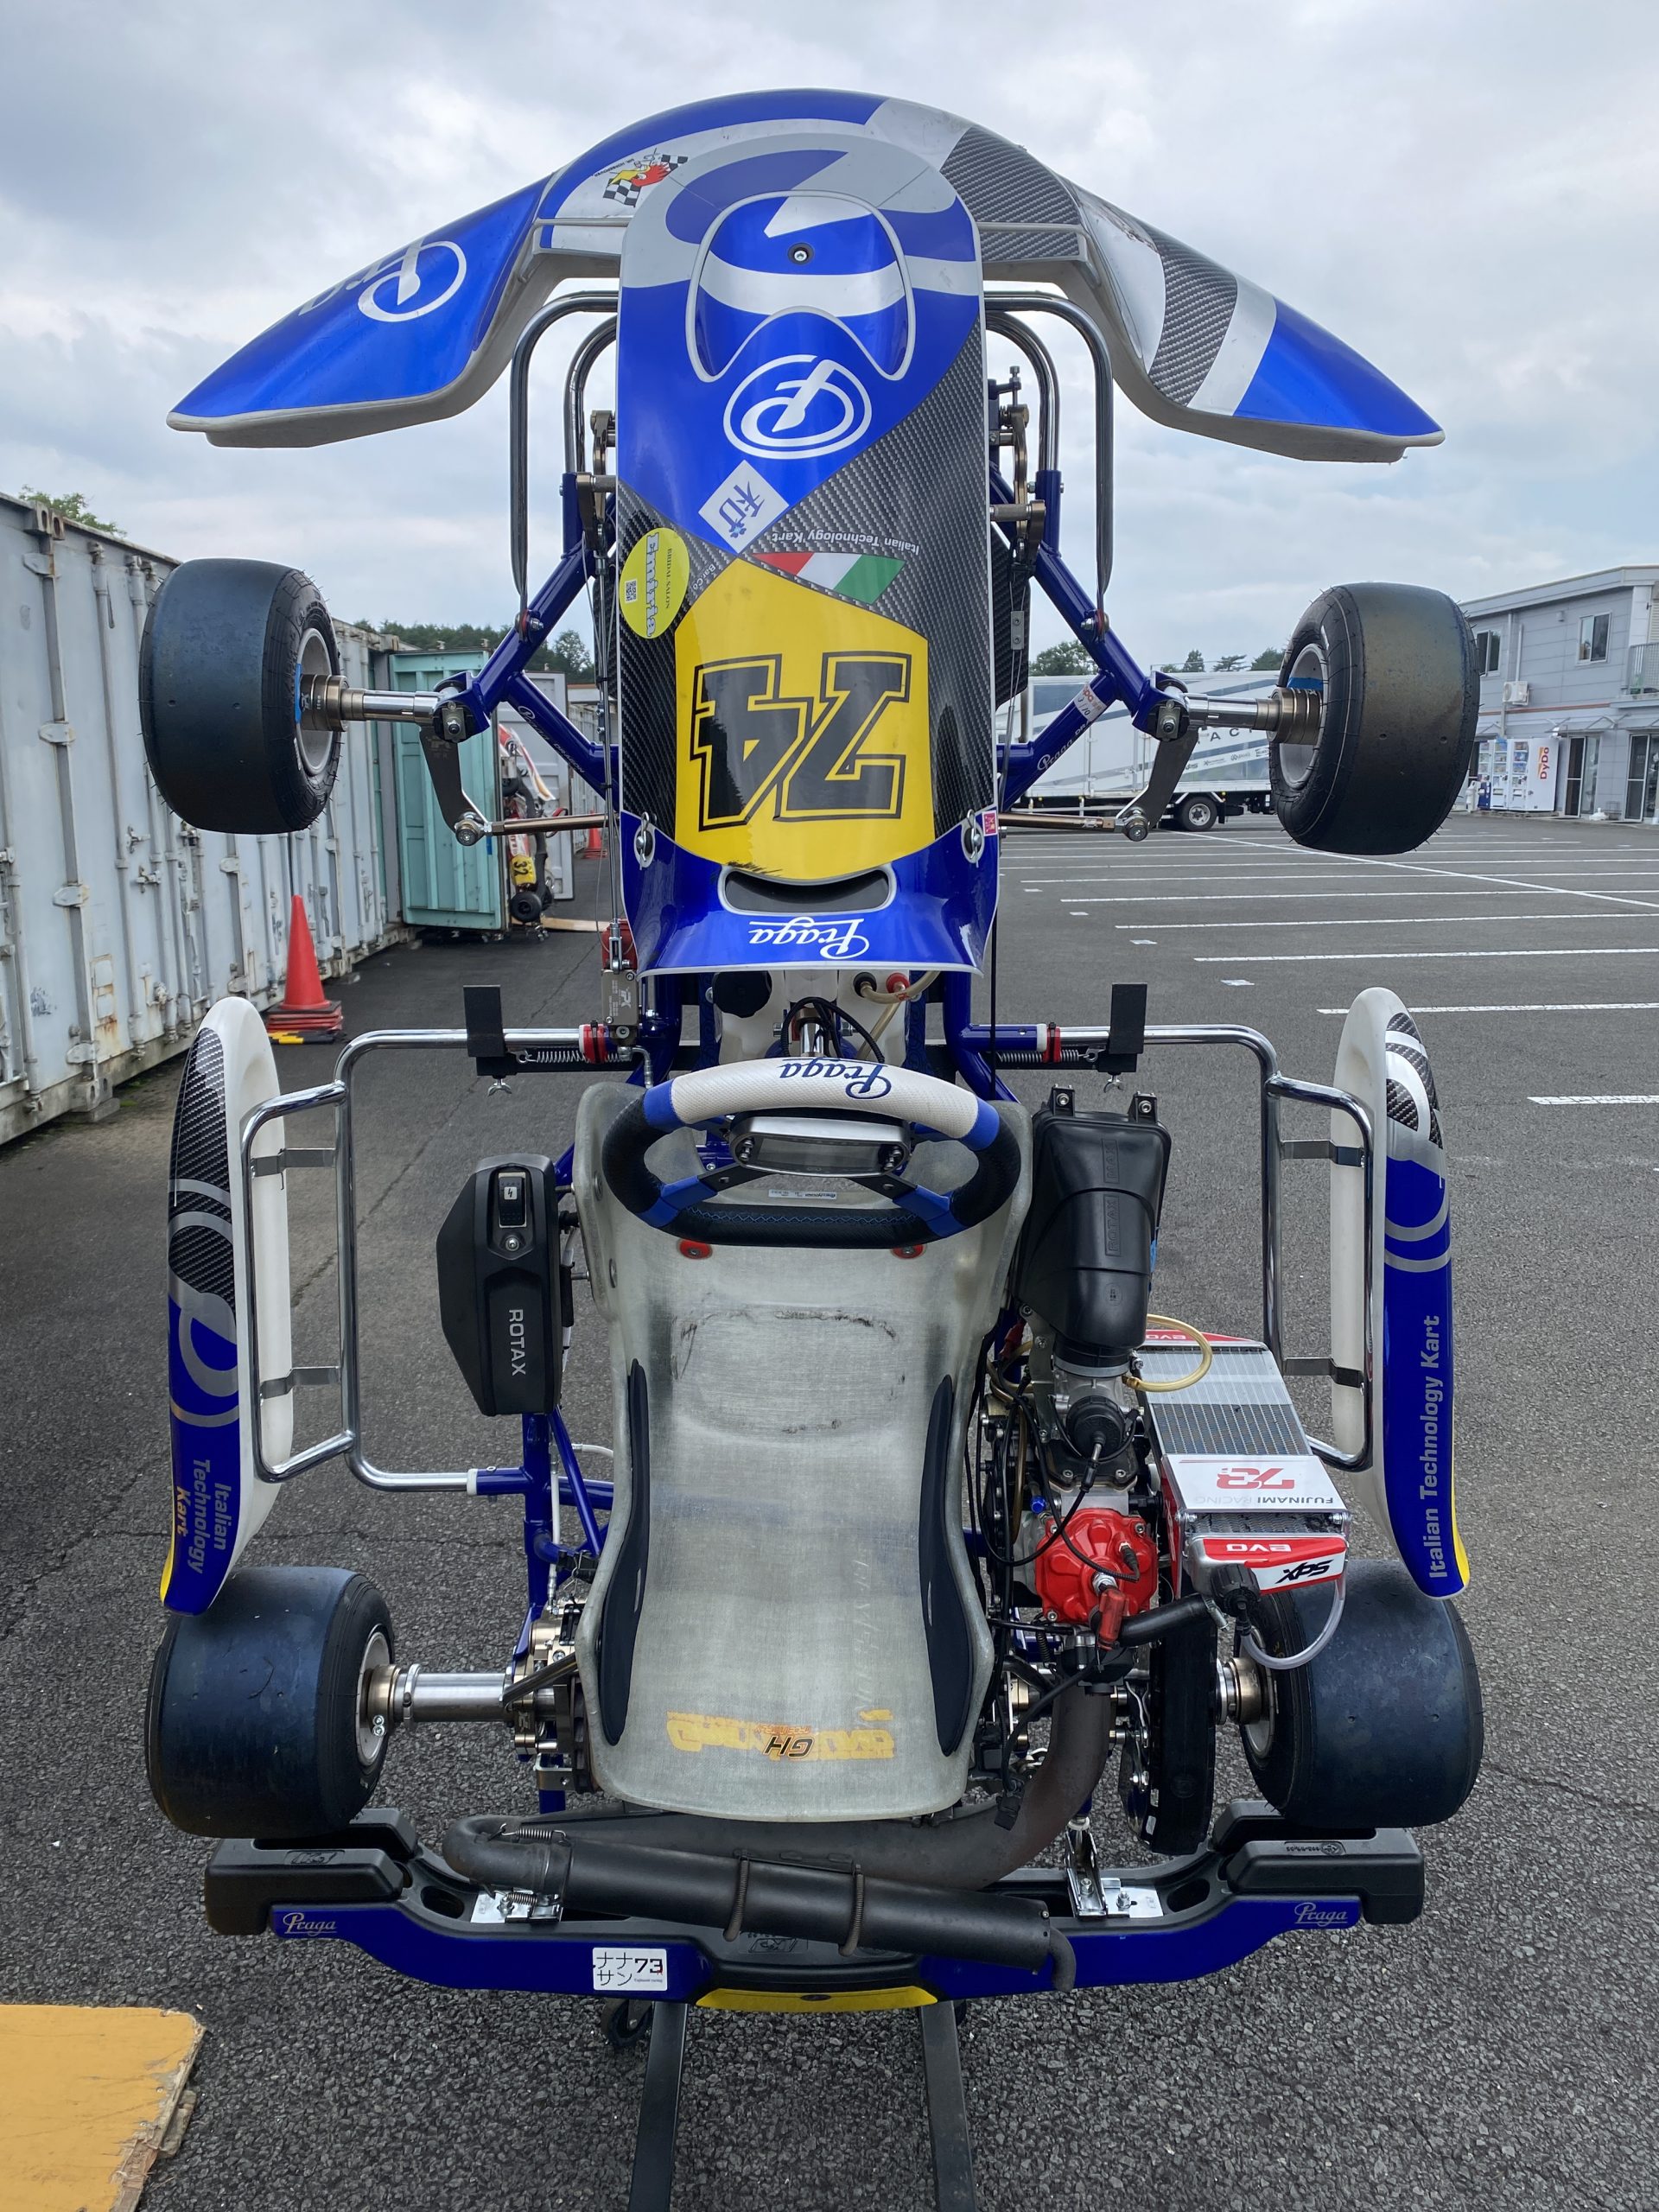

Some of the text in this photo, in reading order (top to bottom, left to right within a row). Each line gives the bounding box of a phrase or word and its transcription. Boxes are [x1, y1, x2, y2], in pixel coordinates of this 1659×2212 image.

[772, 529, 920, 555] Italian Technology Kart
[646, 532, 659, 637] Emiria
[690, 651, 912, 831] 74
[1540, 747, 1550, 779] DyDo
[513, 861, 529, 877] 32
[749, 916, 872, 961] Praga
[779, 1058, 893, 1100] Praga
[1105, 1144, 1119, 1251] ROTAX MAX
[507, 1308, 526, 1377] ROTAX
[1419, 1315, 1447, 1579] Italian Technology Kart
[1216, 1467, 1295, 1490] 73
[175, 1487, 193, 1536] Kart
[1194, 1496, 1253, 1504] RACING
[189, 1459, 212, 1574] Technology
[213, 1483, 232, 1551] Italian
[763, 1735, 815, 1758] GH
[283, 1912, 337, 1937] Praga
[1294, 1902, 1349, 1927] Praga
[596, 1951, 633, 1969] ナナ
[634, 1958, 664, 1974] 73
[596, 1970, 632, 1986] サン
